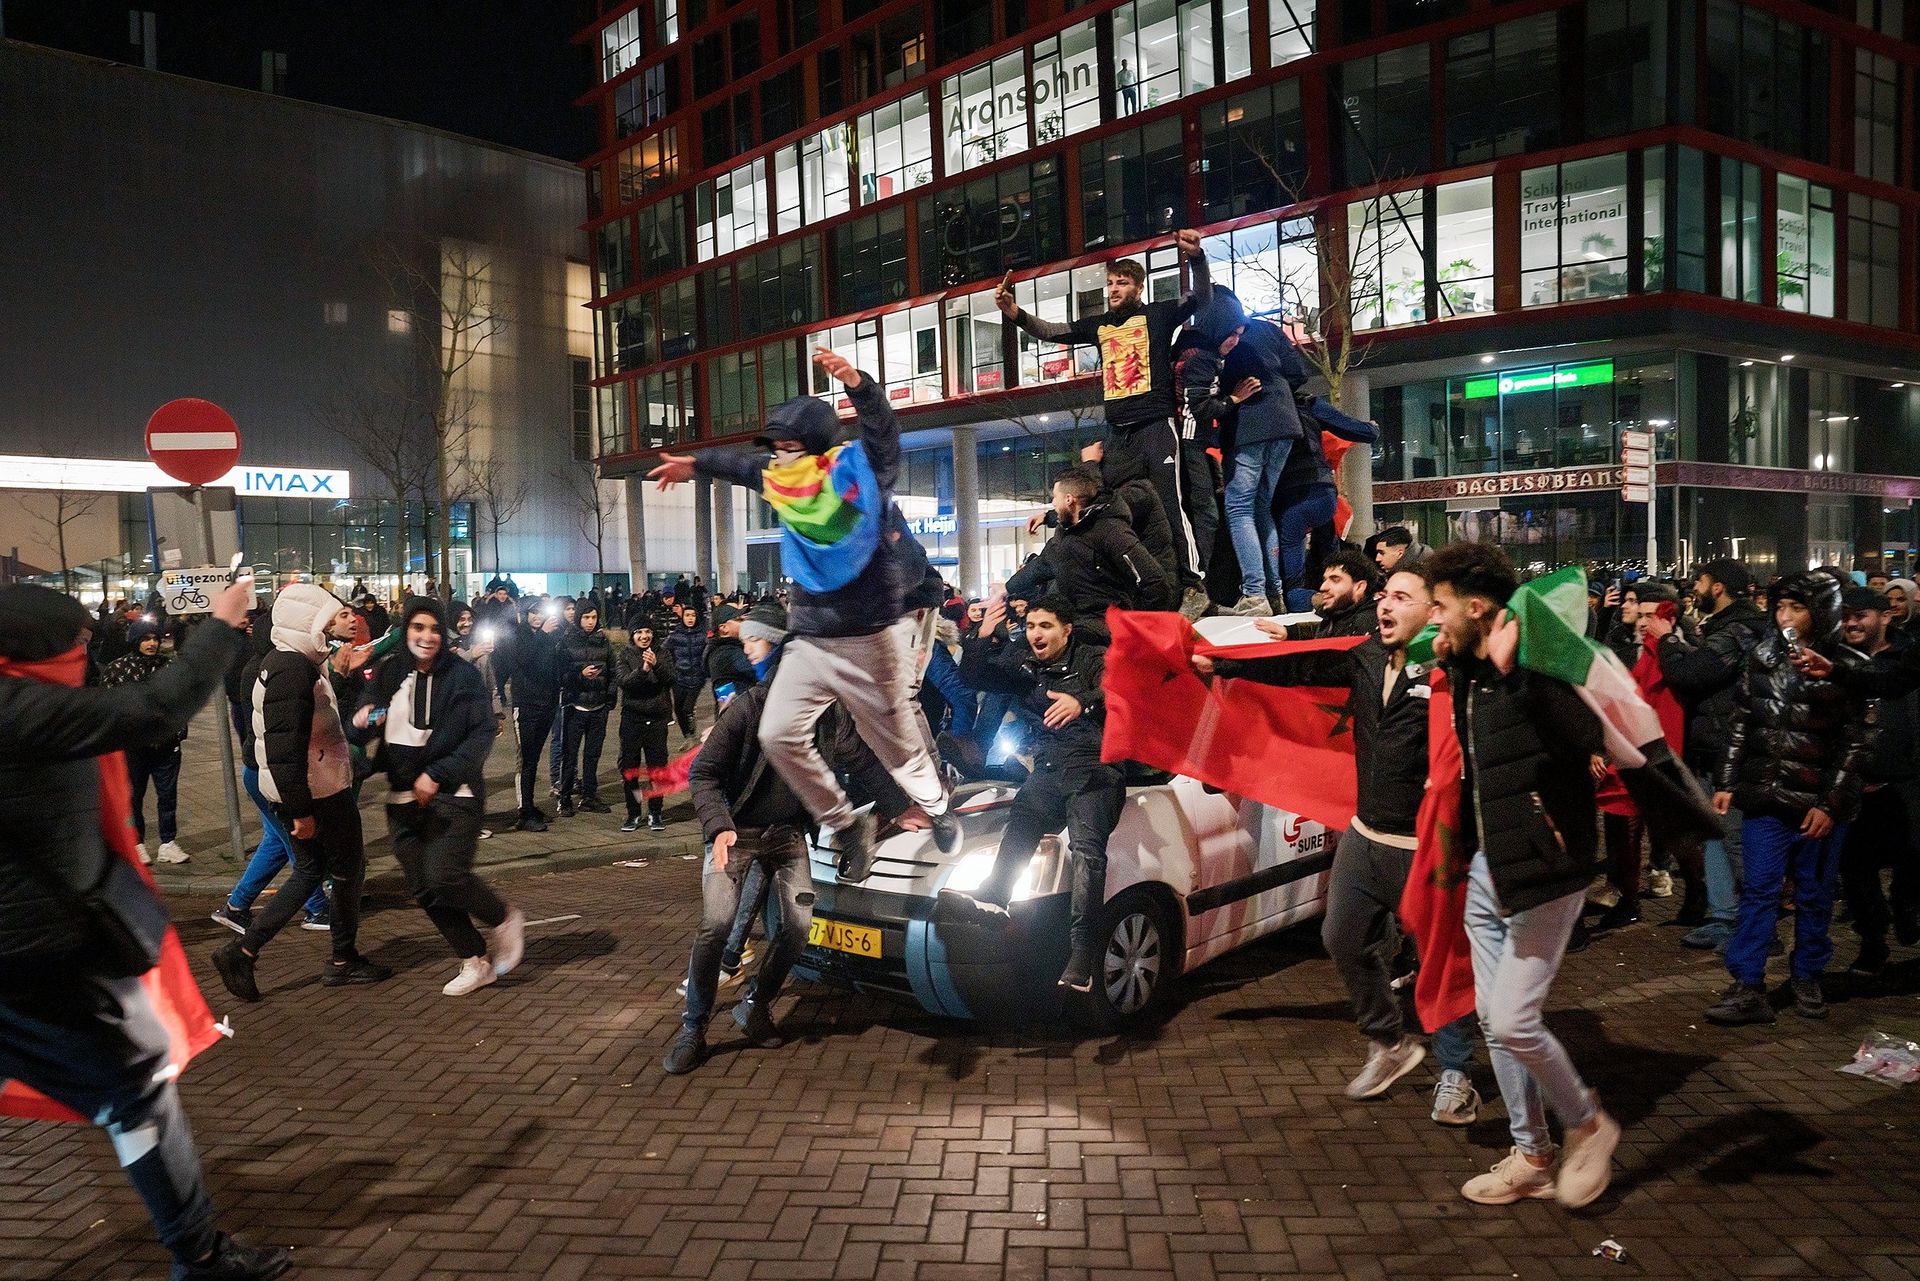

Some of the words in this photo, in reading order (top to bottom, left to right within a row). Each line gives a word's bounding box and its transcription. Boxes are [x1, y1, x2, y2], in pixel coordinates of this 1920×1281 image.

[948, 63, 1091, 138] Aronsohn
[1524, 195, 1571, 214] Travel
[1524, 204, 1622, 231] International
[245, 472, 334, 493] IMAX
[923, 516, 957, 536] Heijn
[812, 922, 871, 952] 7-VJS-6
